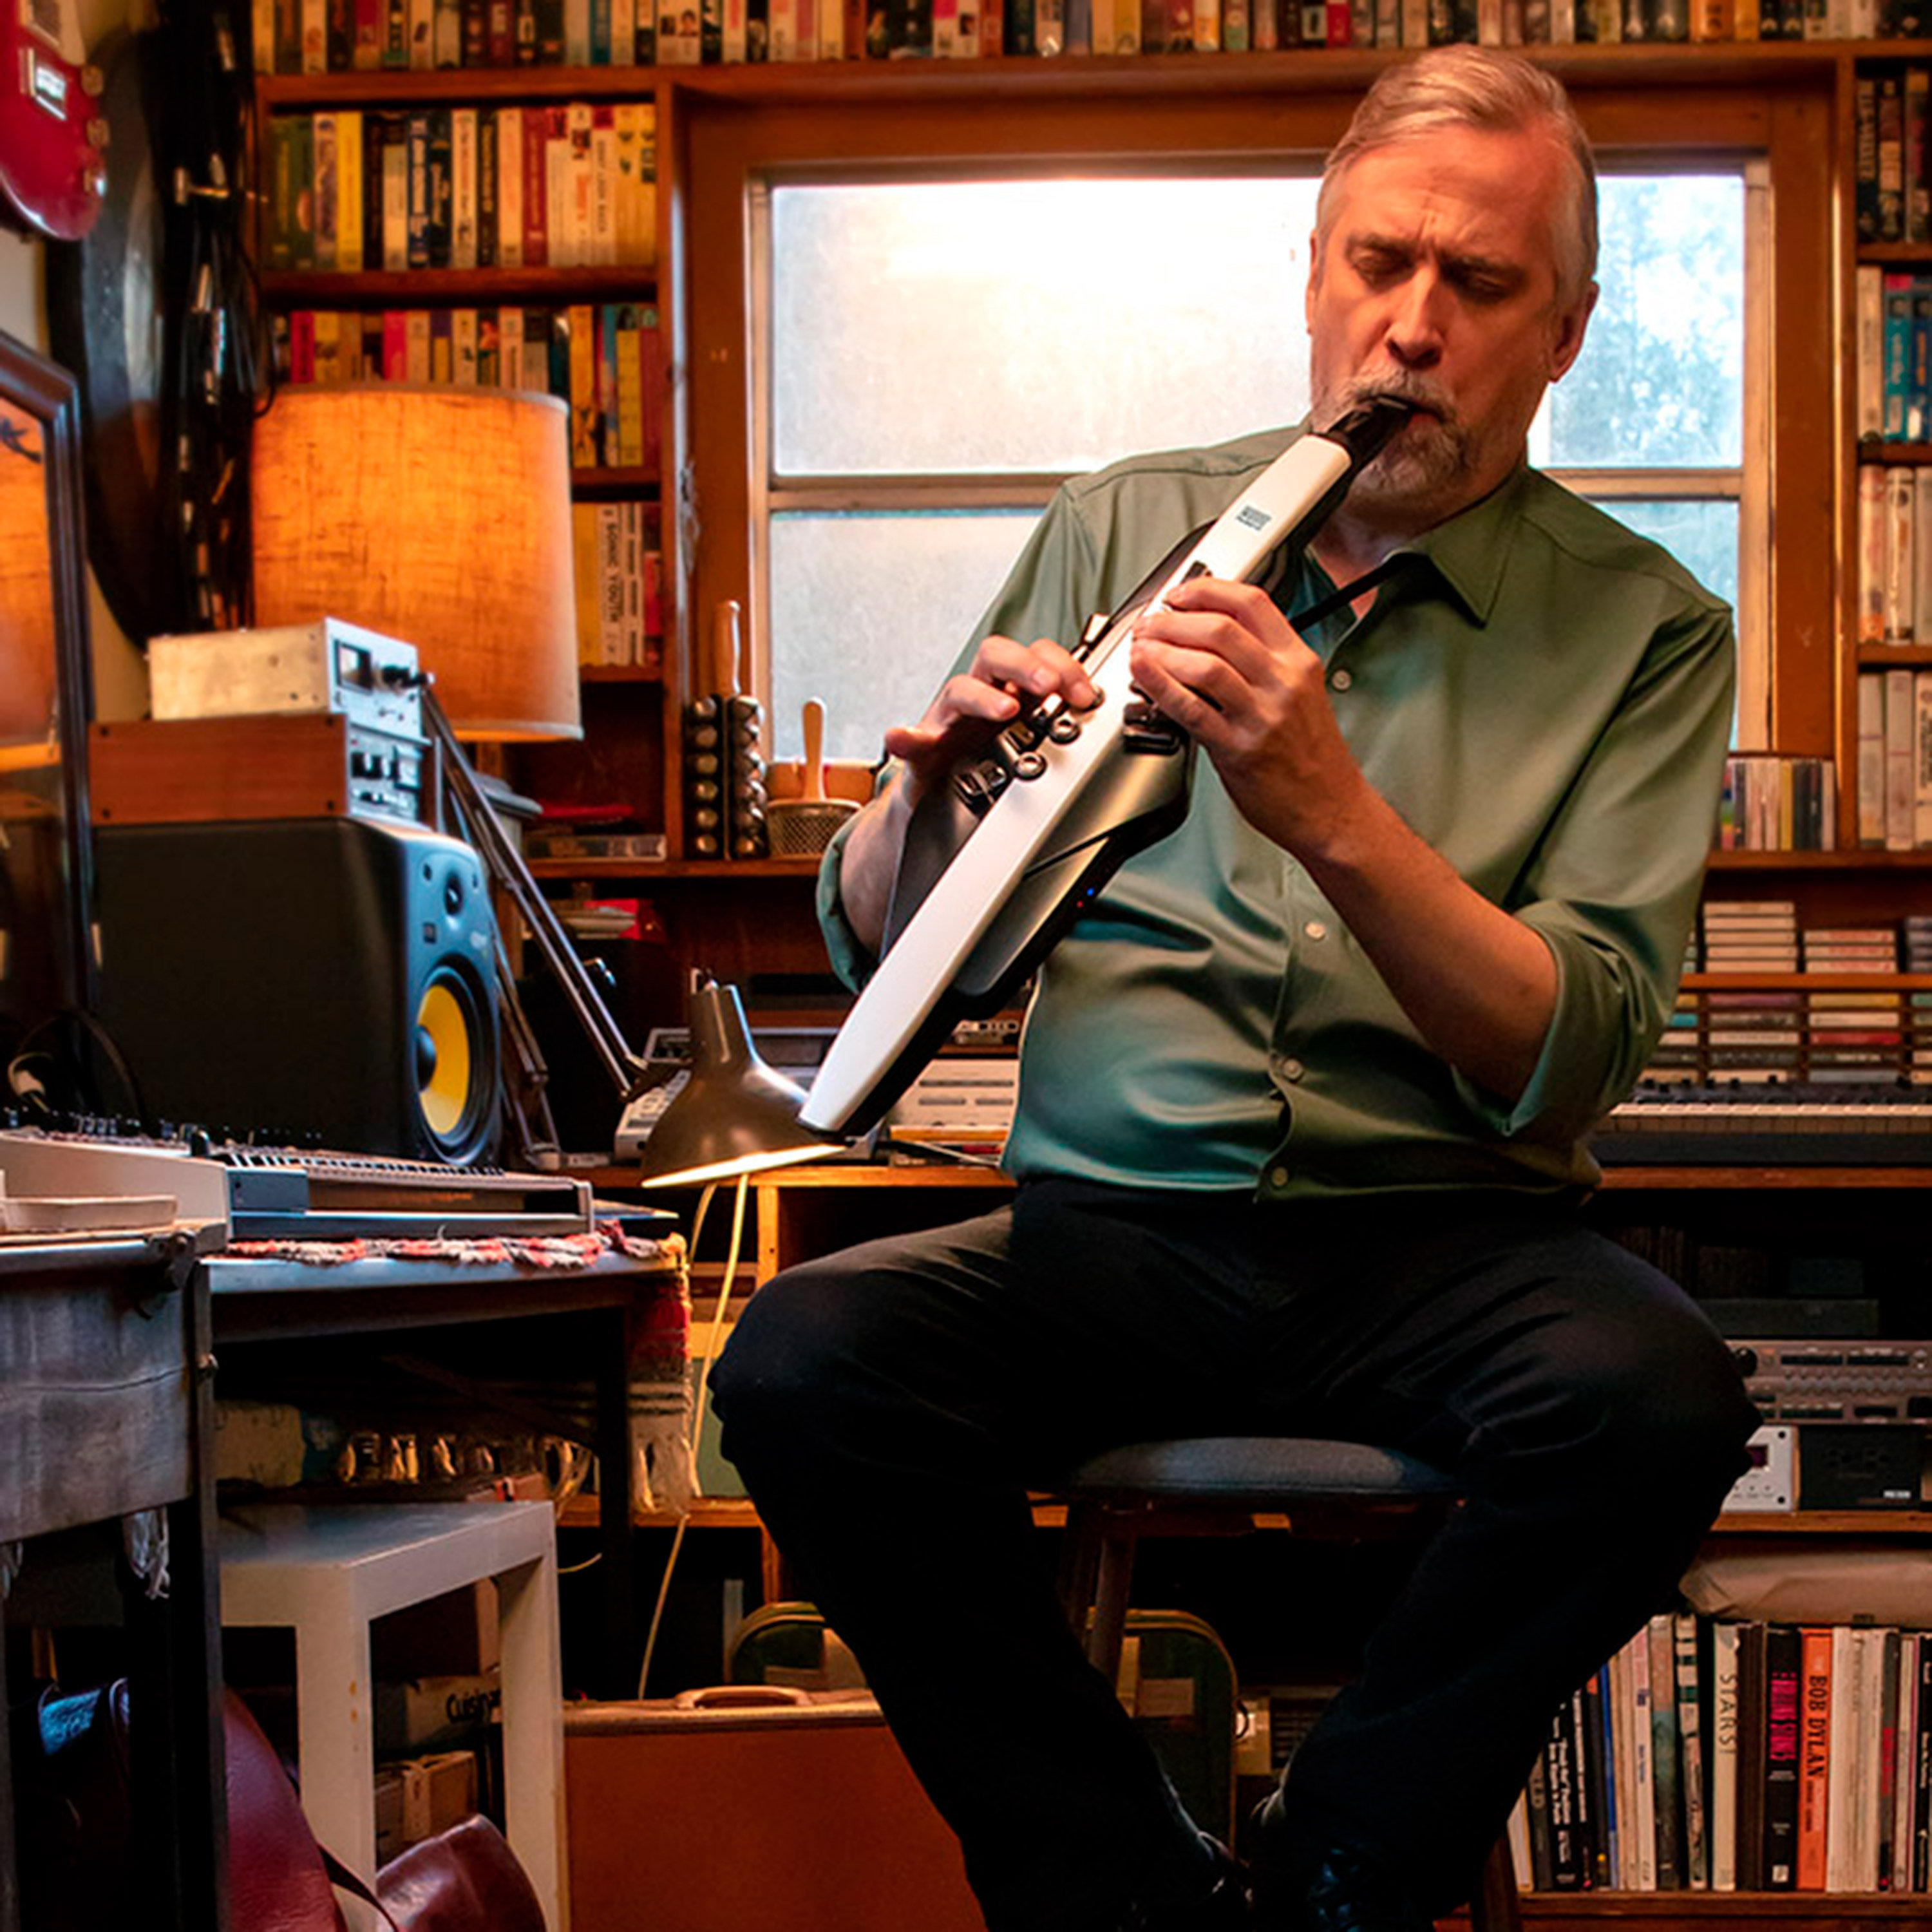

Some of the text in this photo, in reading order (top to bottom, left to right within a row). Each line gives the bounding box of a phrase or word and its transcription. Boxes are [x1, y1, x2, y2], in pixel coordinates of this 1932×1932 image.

[609, 574, 620, 623] YOUTH
[1809, 1675, 1827, 1712] BOB
[1806, 1717, 1826, 1779] DYLAN
